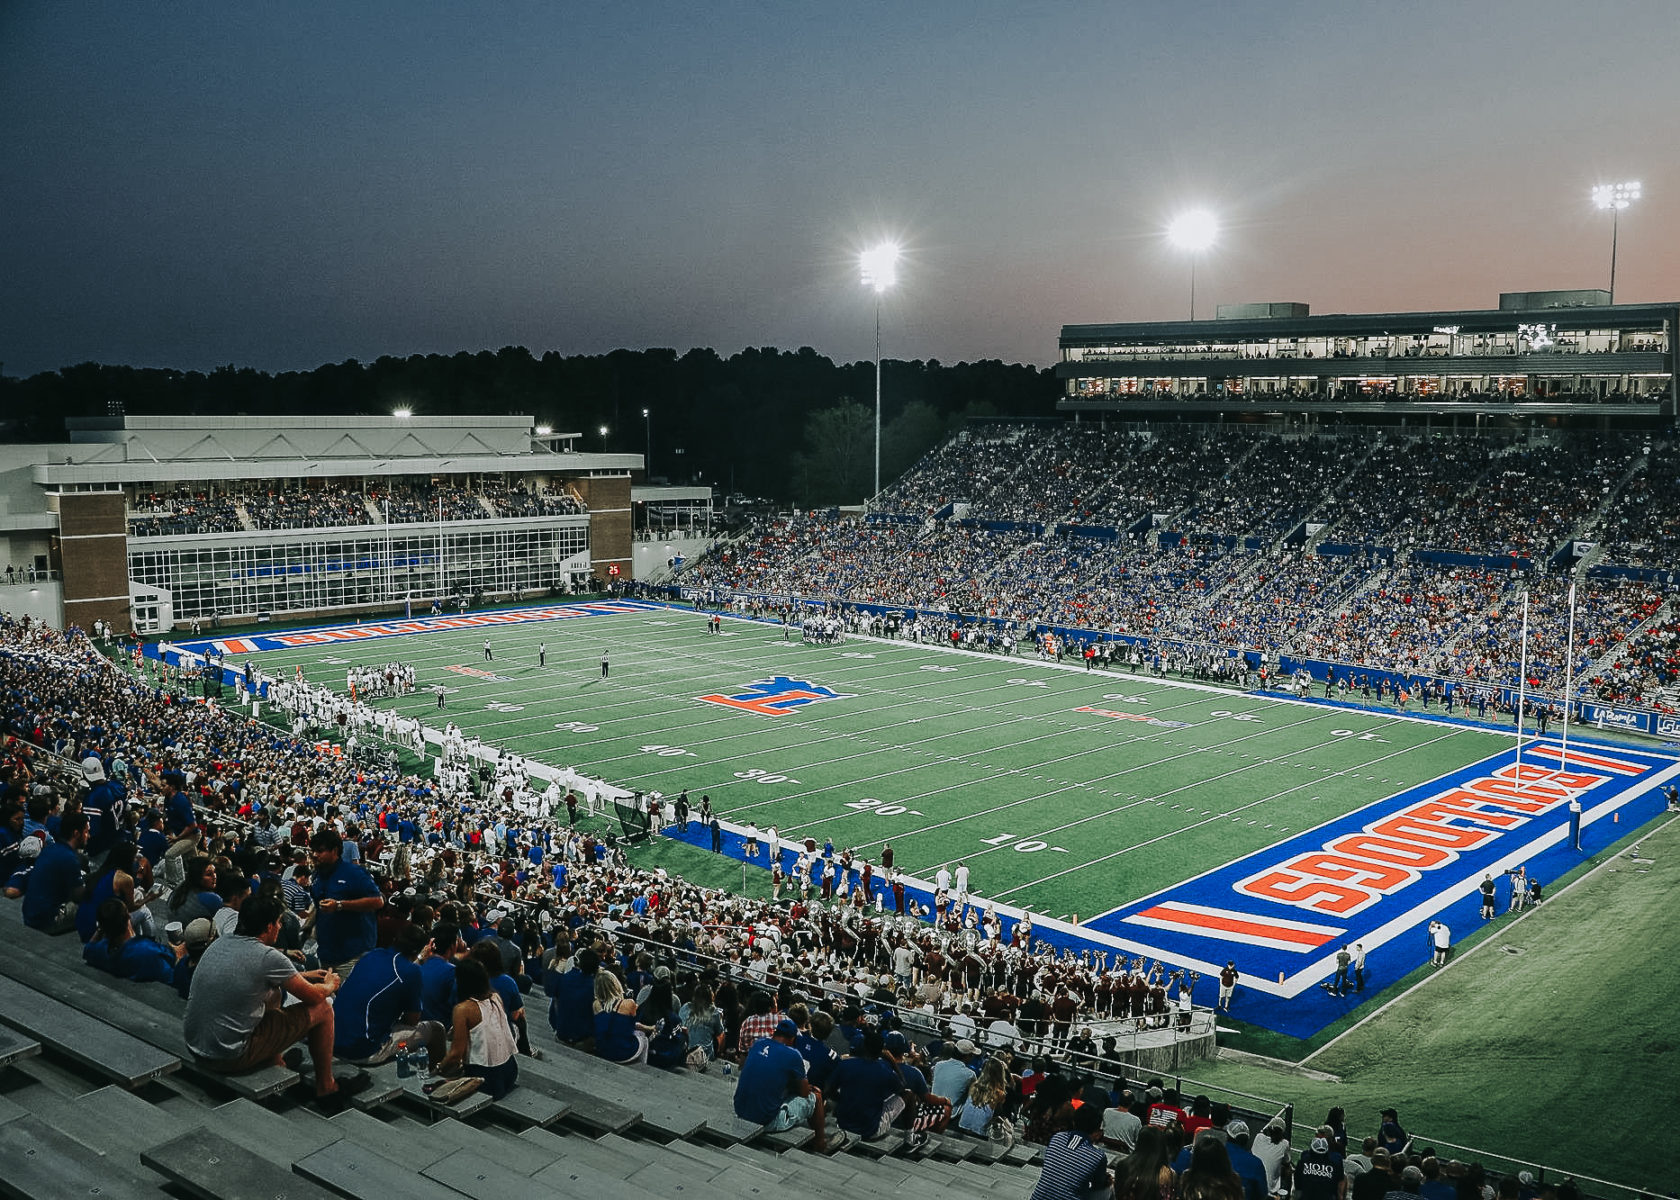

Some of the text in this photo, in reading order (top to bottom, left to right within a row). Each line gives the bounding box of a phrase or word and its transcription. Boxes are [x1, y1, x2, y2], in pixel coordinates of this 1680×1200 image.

[609, 566, 619, 575] 25
[270, 607, 591, 646] BULLDOGS
[1330, 728, 1382, 741] 10
[638, 745, 687, 756] 40
[733, 769, 788, 784] 30
[844, 798, 907, 816] 20
[979, 833, 1049, 852] 10
[1232, 762, 1614, 918] BULLDOGS
[1303, 1163, 1334, 1173] MOJO
